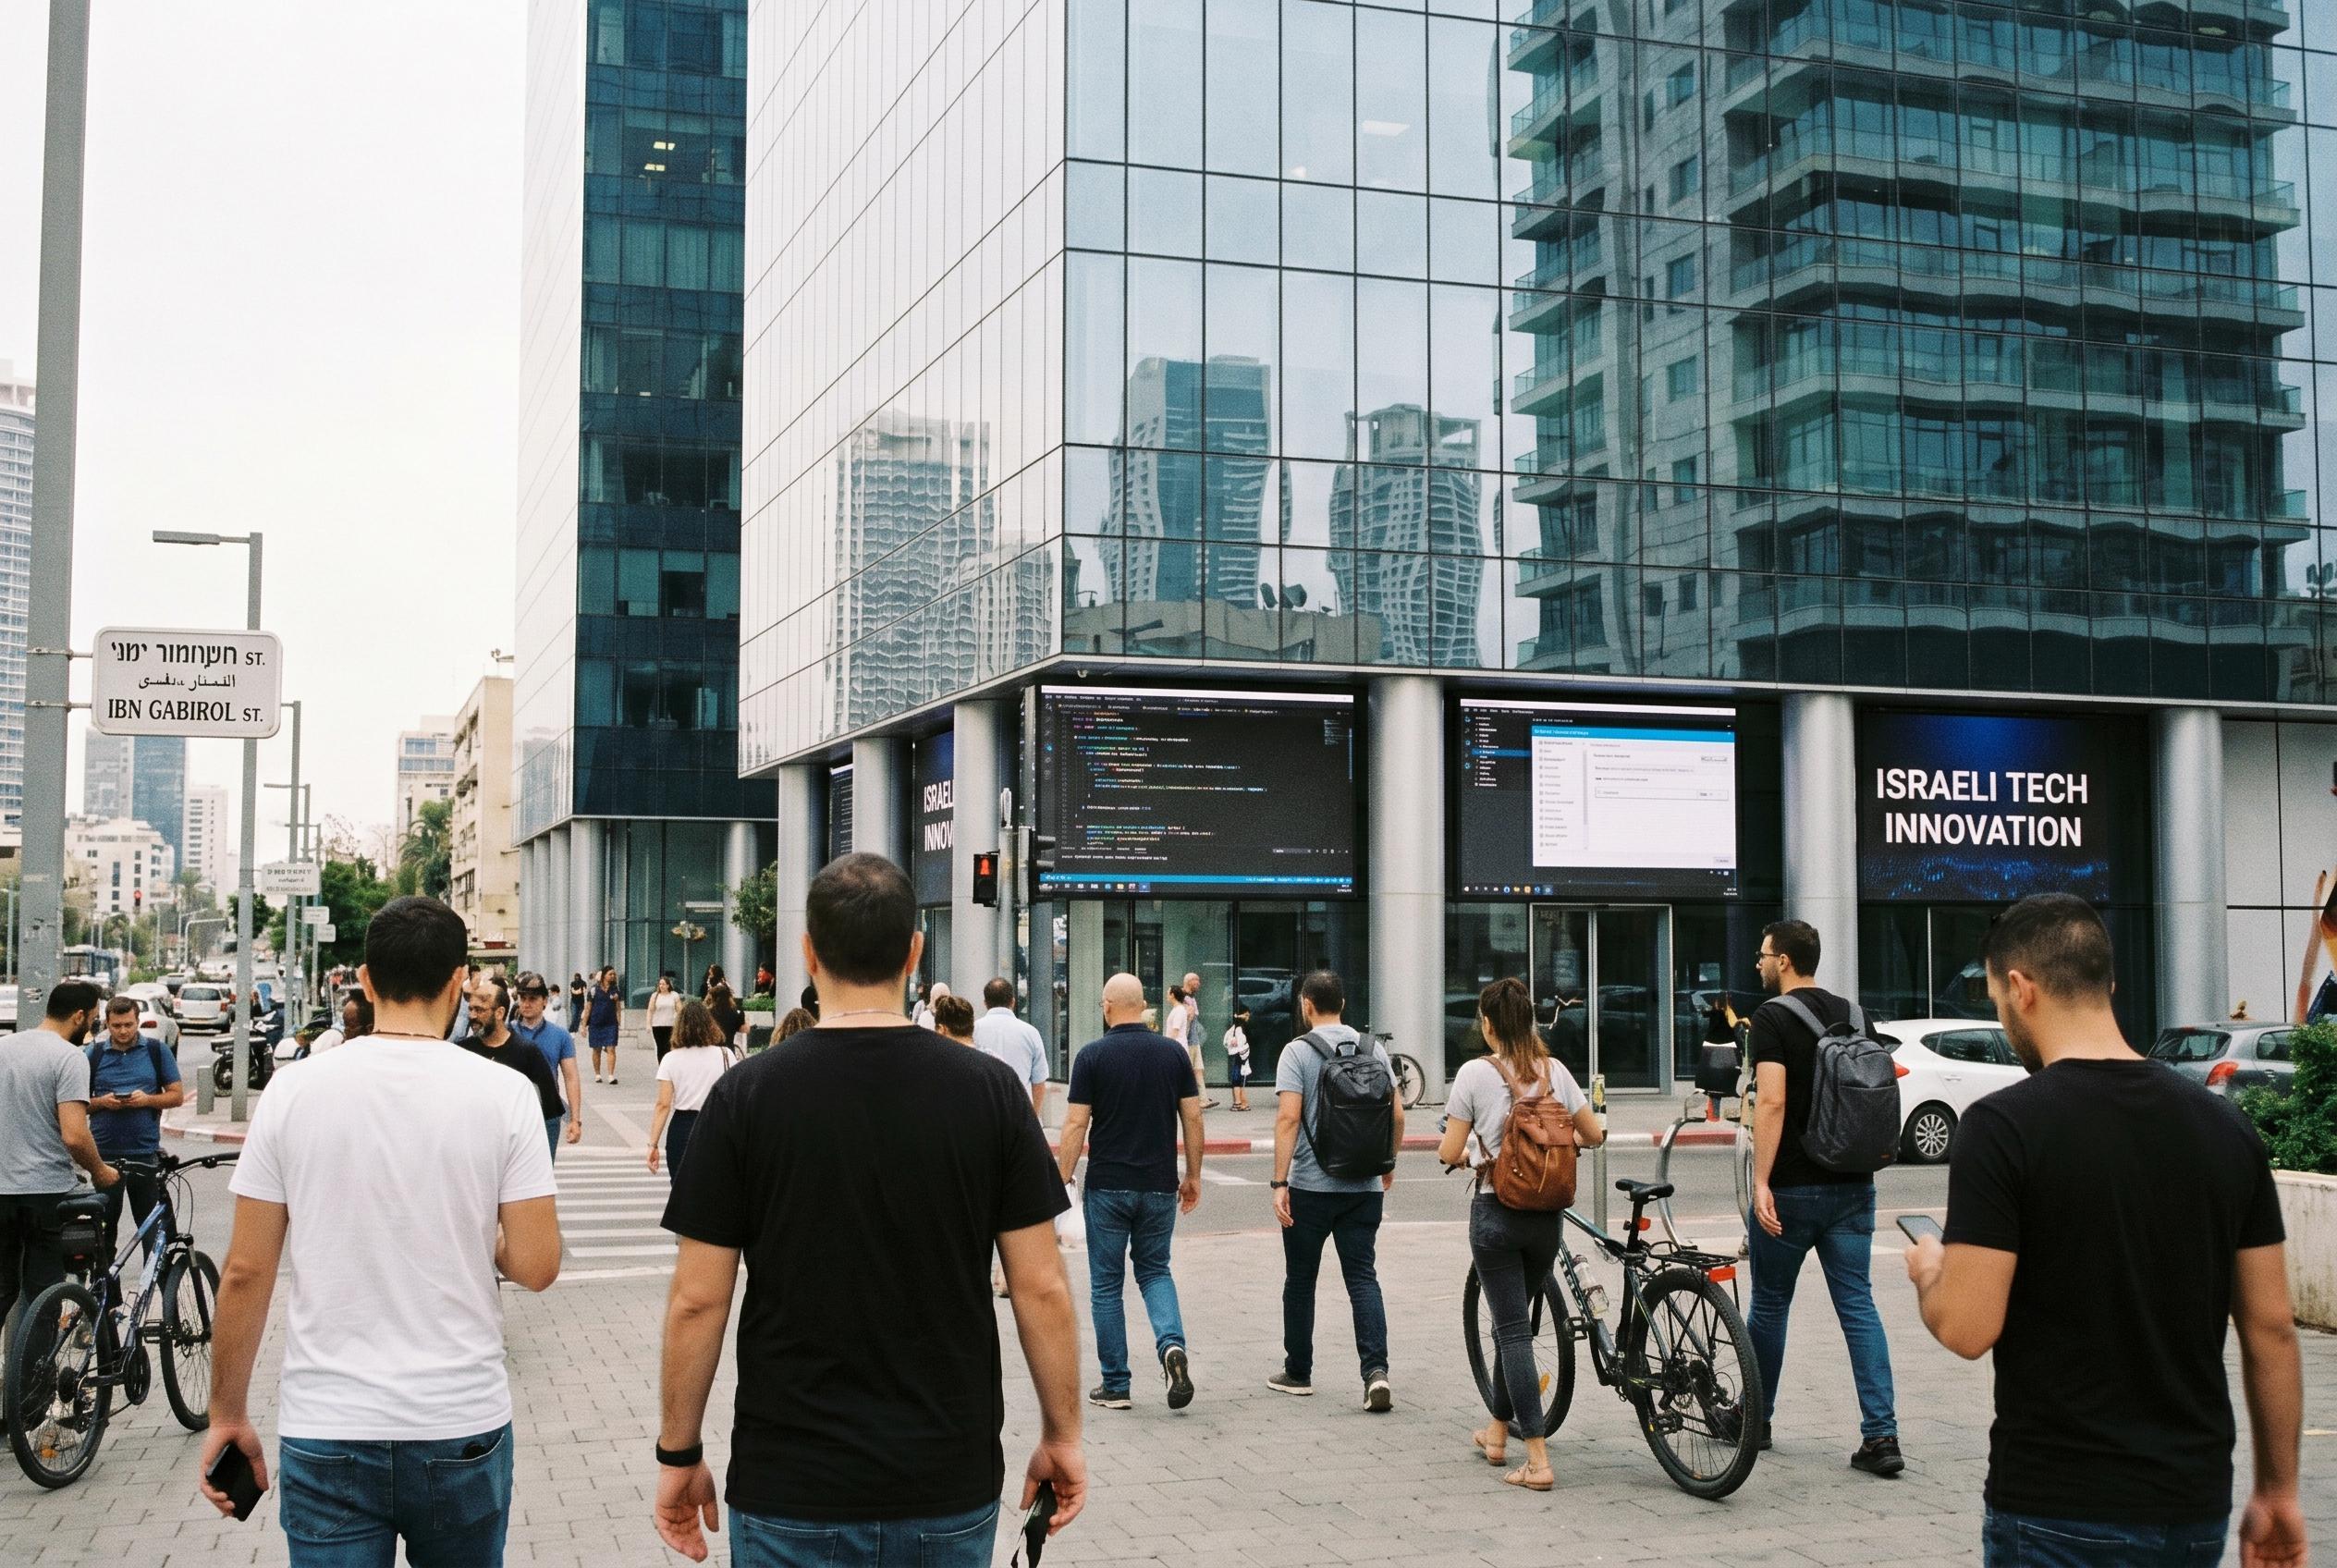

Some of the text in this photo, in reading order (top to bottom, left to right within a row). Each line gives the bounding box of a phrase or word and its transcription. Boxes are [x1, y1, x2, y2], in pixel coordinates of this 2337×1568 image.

[245, 652, 265, 666] ST.
[108, 699, 263, 722] IBN GABIROL ST.
[1877, 768, 2087, 803] ISRAELI TECH
[1886, 813, 2081, 847] INNOVATION
